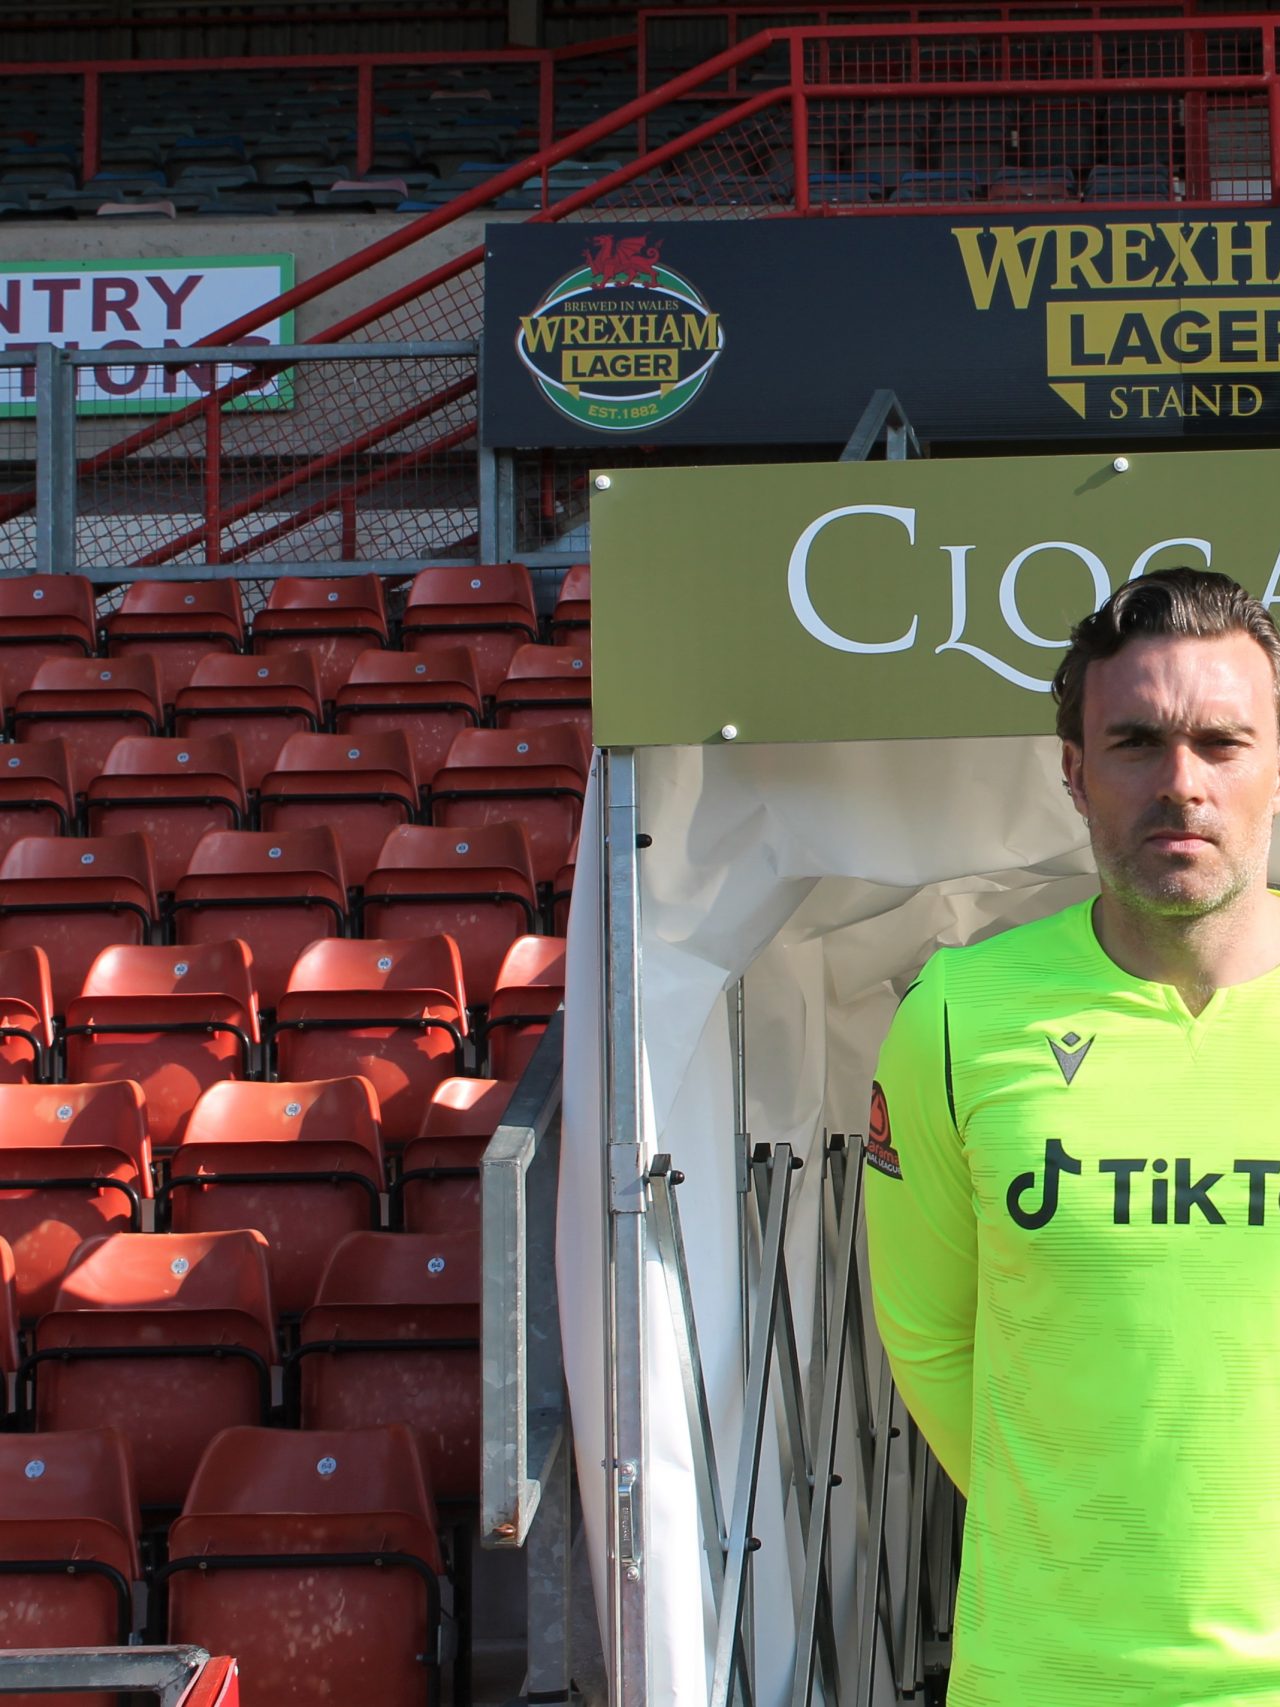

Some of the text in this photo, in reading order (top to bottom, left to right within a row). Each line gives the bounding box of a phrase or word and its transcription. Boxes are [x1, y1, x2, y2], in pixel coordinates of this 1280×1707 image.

[563, 300, 679, 312] BREWED IN WALES
[519, 312, 720, 353] WREXHAM
[571, 353, 672, 378] LAGER
[1109, 384, 1263, 419] STAND
